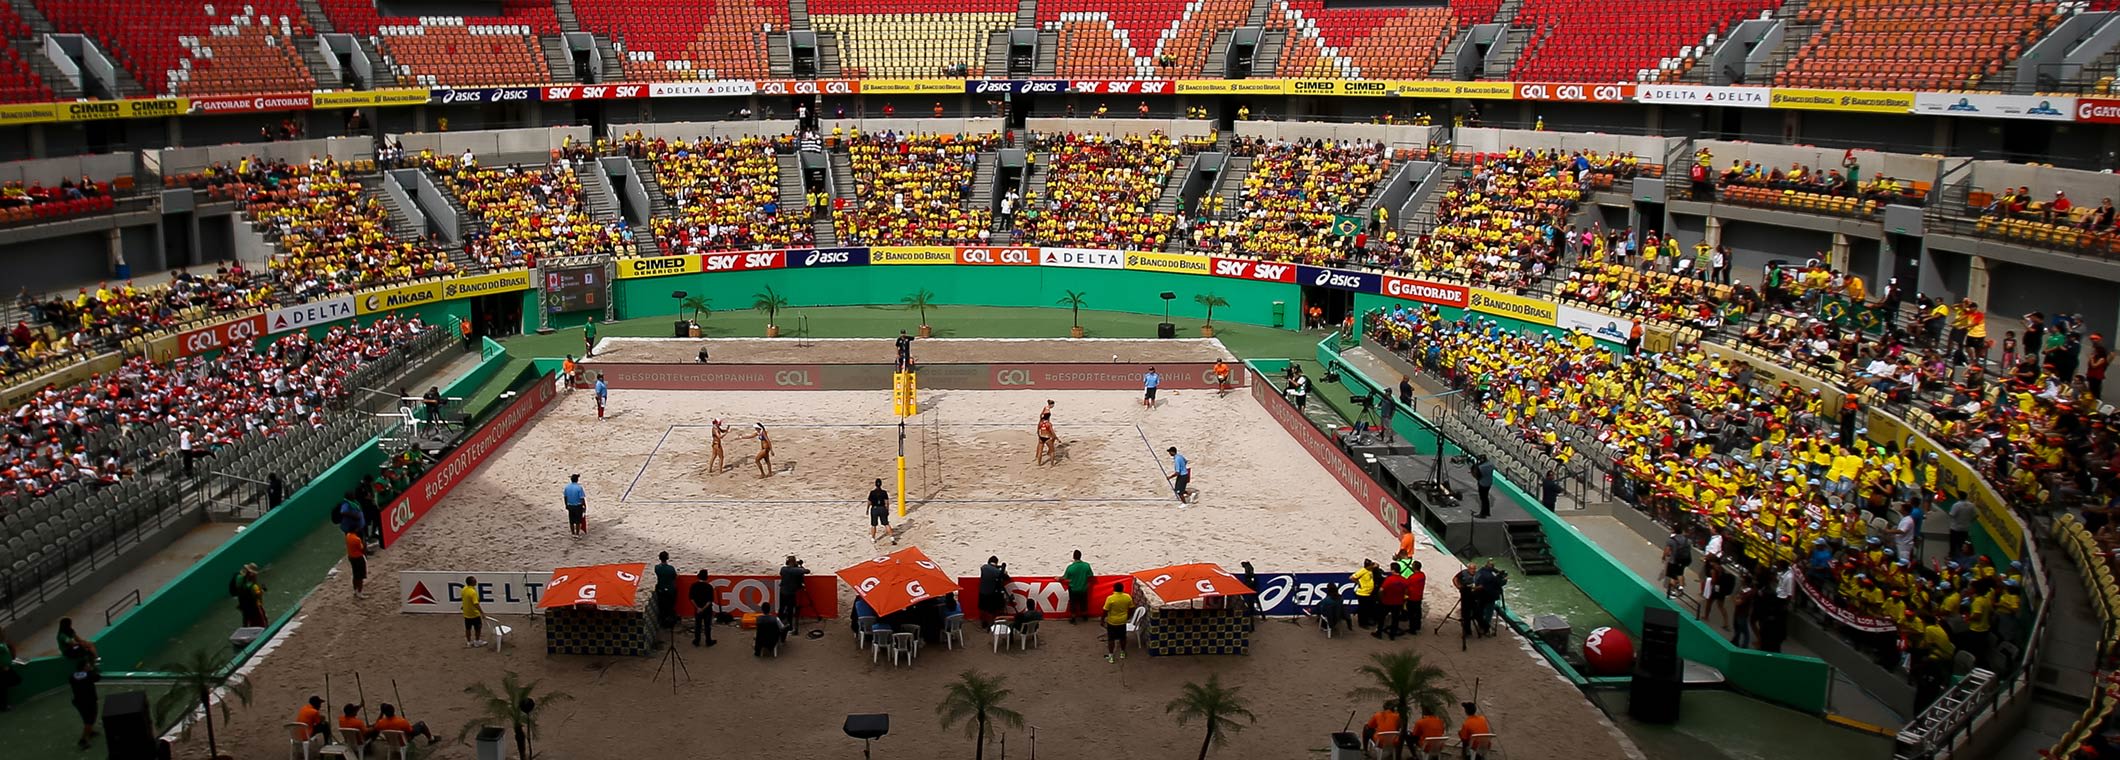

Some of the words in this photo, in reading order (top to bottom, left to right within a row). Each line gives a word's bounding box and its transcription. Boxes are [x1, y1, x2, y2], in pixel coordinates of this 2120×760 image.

[549, 88, 574, 99] SKY
[582, 87, 607, 98] SKY
[616, 86, 641, 97] SKY
[763, 82, 789, 94] GOL
[794, 82, 820, 94] GOL
[826, 82, 852, 94] GOL
[1076, 82, 1100, 92] SKY
[1108, 82, 1132, 92] SKY
[1140, 82, 1166, 92] SKY
[1344, 82, 1385, 90] CIMED
[1521, 85, 1550, 99] GOL
[1556, 86, 1587, 100] GOL
[1593, 86, 1623, 100] GOL
[1656, 90, 1696, 99] DELTA
[1718, 92, 1762, 102] DELTA
[70, 103, 119, 113] CIMED
[131, 101, 177, 111] CIMED
[203, 100, 250, 110] GATORADE
[254, 98, 264, 109] G
[265, 98, 309, 108] GATORADE
[2079, 103, 2094, 118] G
[706, 254, 738, 271] SKY
[745, 253, 776, 268] SKY
[819, 252, 849, 263] asics
[885, 252, 913, 260] BANCO
[925, 252, 951, 260] BRASIL
[963, 249, 994, 263] GOL
[1000, 249, 1032, 263] GOL
[1063, 252, 1118, 265] DELTA
[1140, 257, 1167, 267] BANCO
[1168, 260, 1179, 268] DO
[1179, 260, 1208, 270] BRASIL
[634, 258, 685, 271] CIMED
[1216, 260, 1249, 276] SKY
[1253, 264, 1287, 280] SKY
[459, 281, 488, 293] BANCO
[488, 280, 499, 289] DO
[500, 277, 526, 288] BRASIL
[1329, 273, 1361, 287] asics
[1388, 279, 1401, 295] G
[1401, 283, 1462, 302] GATORADE
[293, 302, 350, 324] DELTA
[1483, 297, 1511, 311] BANCO
[1511, 303, 1523, 314] DO
[1524, 305, 1553, 320] BRASIL
[187, 330, 221, 352] GOL
[228, 319, 259, 341] GOL
[618, 373, 764, 382] #oESPORTEtemCOMPANHIA
[775, 370, 813, 385] GOL
[997, 369, 1035, 385] GOL
[1045, 373, 1191, 382] #oESPORTEtemCOANHIA
[390, 496, 415, 533] GOL
[424, 396, 535, 502] #oESPORTEtemCOMPANHIA
[1380, 496, 1401, 535] GOL
[448, 582, 544, 603] DELT
[578, 584, 597, 599] G
[905, 580, 925, 597] G
[1195, 579, 1215, 592] G
